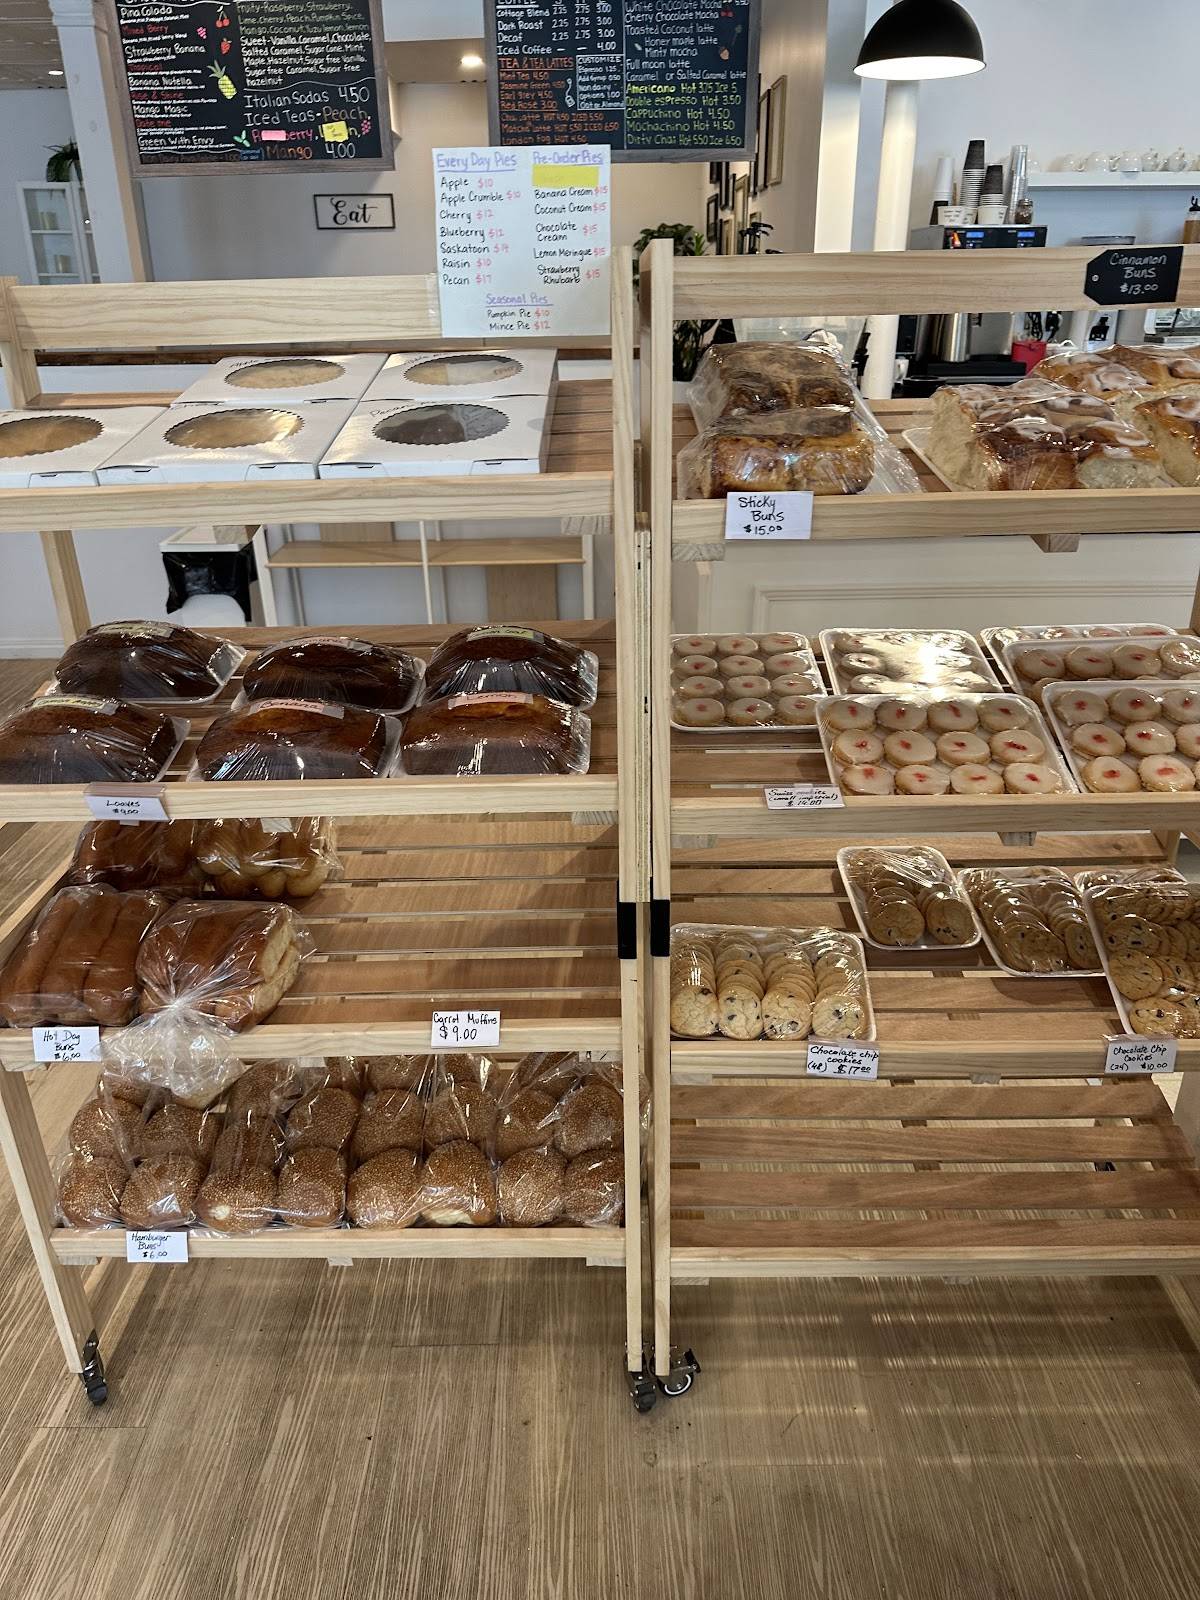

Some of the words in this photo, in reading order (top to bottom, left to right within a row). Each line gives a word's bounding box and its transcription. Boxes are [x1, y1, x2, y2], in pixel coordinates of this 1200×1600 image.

[625, 13, 653, 23] Cherry
[656, 12, 693, 22] Chocolate
[695, 10, 719, 19] Mocha
[518, 20, 543, 30] Roast
[625, 24, 659, 35] Toasted
[661, 24, 693, 34] Coconut
[125, 46, 172, 58] Strawberry
[174, 43, 206, 54] Banana
[497, 45, 519, 55] Iced
[522, 45, 552, 54] Coffee
[129, 77, 160, 86] Banana
[162, 76, 192, 85] Nutella
[626, 83, 676, 94] Americano
[681, 83, 697, 93] Hot
[244, 94, 291, 108] Italian
[292, 91, 329, 104] Sodas
[133, 106, 160, 114] Mango
[687, 108, 704, 119] Hot
[244, 112, 280, 127] Iced
[138, 137, 167, 147] Green
[192, 137, 214, 145] Envy
[266, 146, 312, 159] Mango
[581, 151, 604, 164] Pies
[437, 154, 469, 170] Every
[471, 153, 491, 169] Day
[495, 153, 517, 166] Pies
[441, 177, 469, 191] Apple
[478, 178, 494, 189] $10
[441, 193, 465, 206] Apple
[468, 192, 504, 201] Crumble
[534, 189, 567, 199] Banana
[569, 188, 593, 196] Cream
[330, 197, 378, 225] Eat
[534, 203, 566, 215] Coconut
[568, 202, 592, 212] Cream
[440, 209, 471, 224] Cherry
[536, 221, 577, 233] Chocolate
[440, 227, 486, 242] Blueberry
[537, 233, 568, 242] Cream
[440, 243, 490, 254] Saskatoon
[533, 247, 557, 259] Lemon
[558, 248, 592, 261] Meringue
[442, 258, 470, 269] Raisin
[1109, 253, 1167, 265] Cinnamon
[537, 265, 580, 277] Strawberry
[1123, 267, 1156, 279] Buns
[443, 274, 470, 285] Pecan
[543, 275, 581, 284] Rhubarb
[486, 293, 527, 305] Seasonal
[530, 293, 548, 304] Pies
[487, 309, 516, 319] Pumpkin
[519, 309, 531, 317] Pie
[489, 321, 514, 331] Mince
[518, 320, 530, 330] Pie
[738, 496, 775, 513] Sticky
[751, 510, 784, 522] Buns
[62, 1030, 80, 1045] Dog
